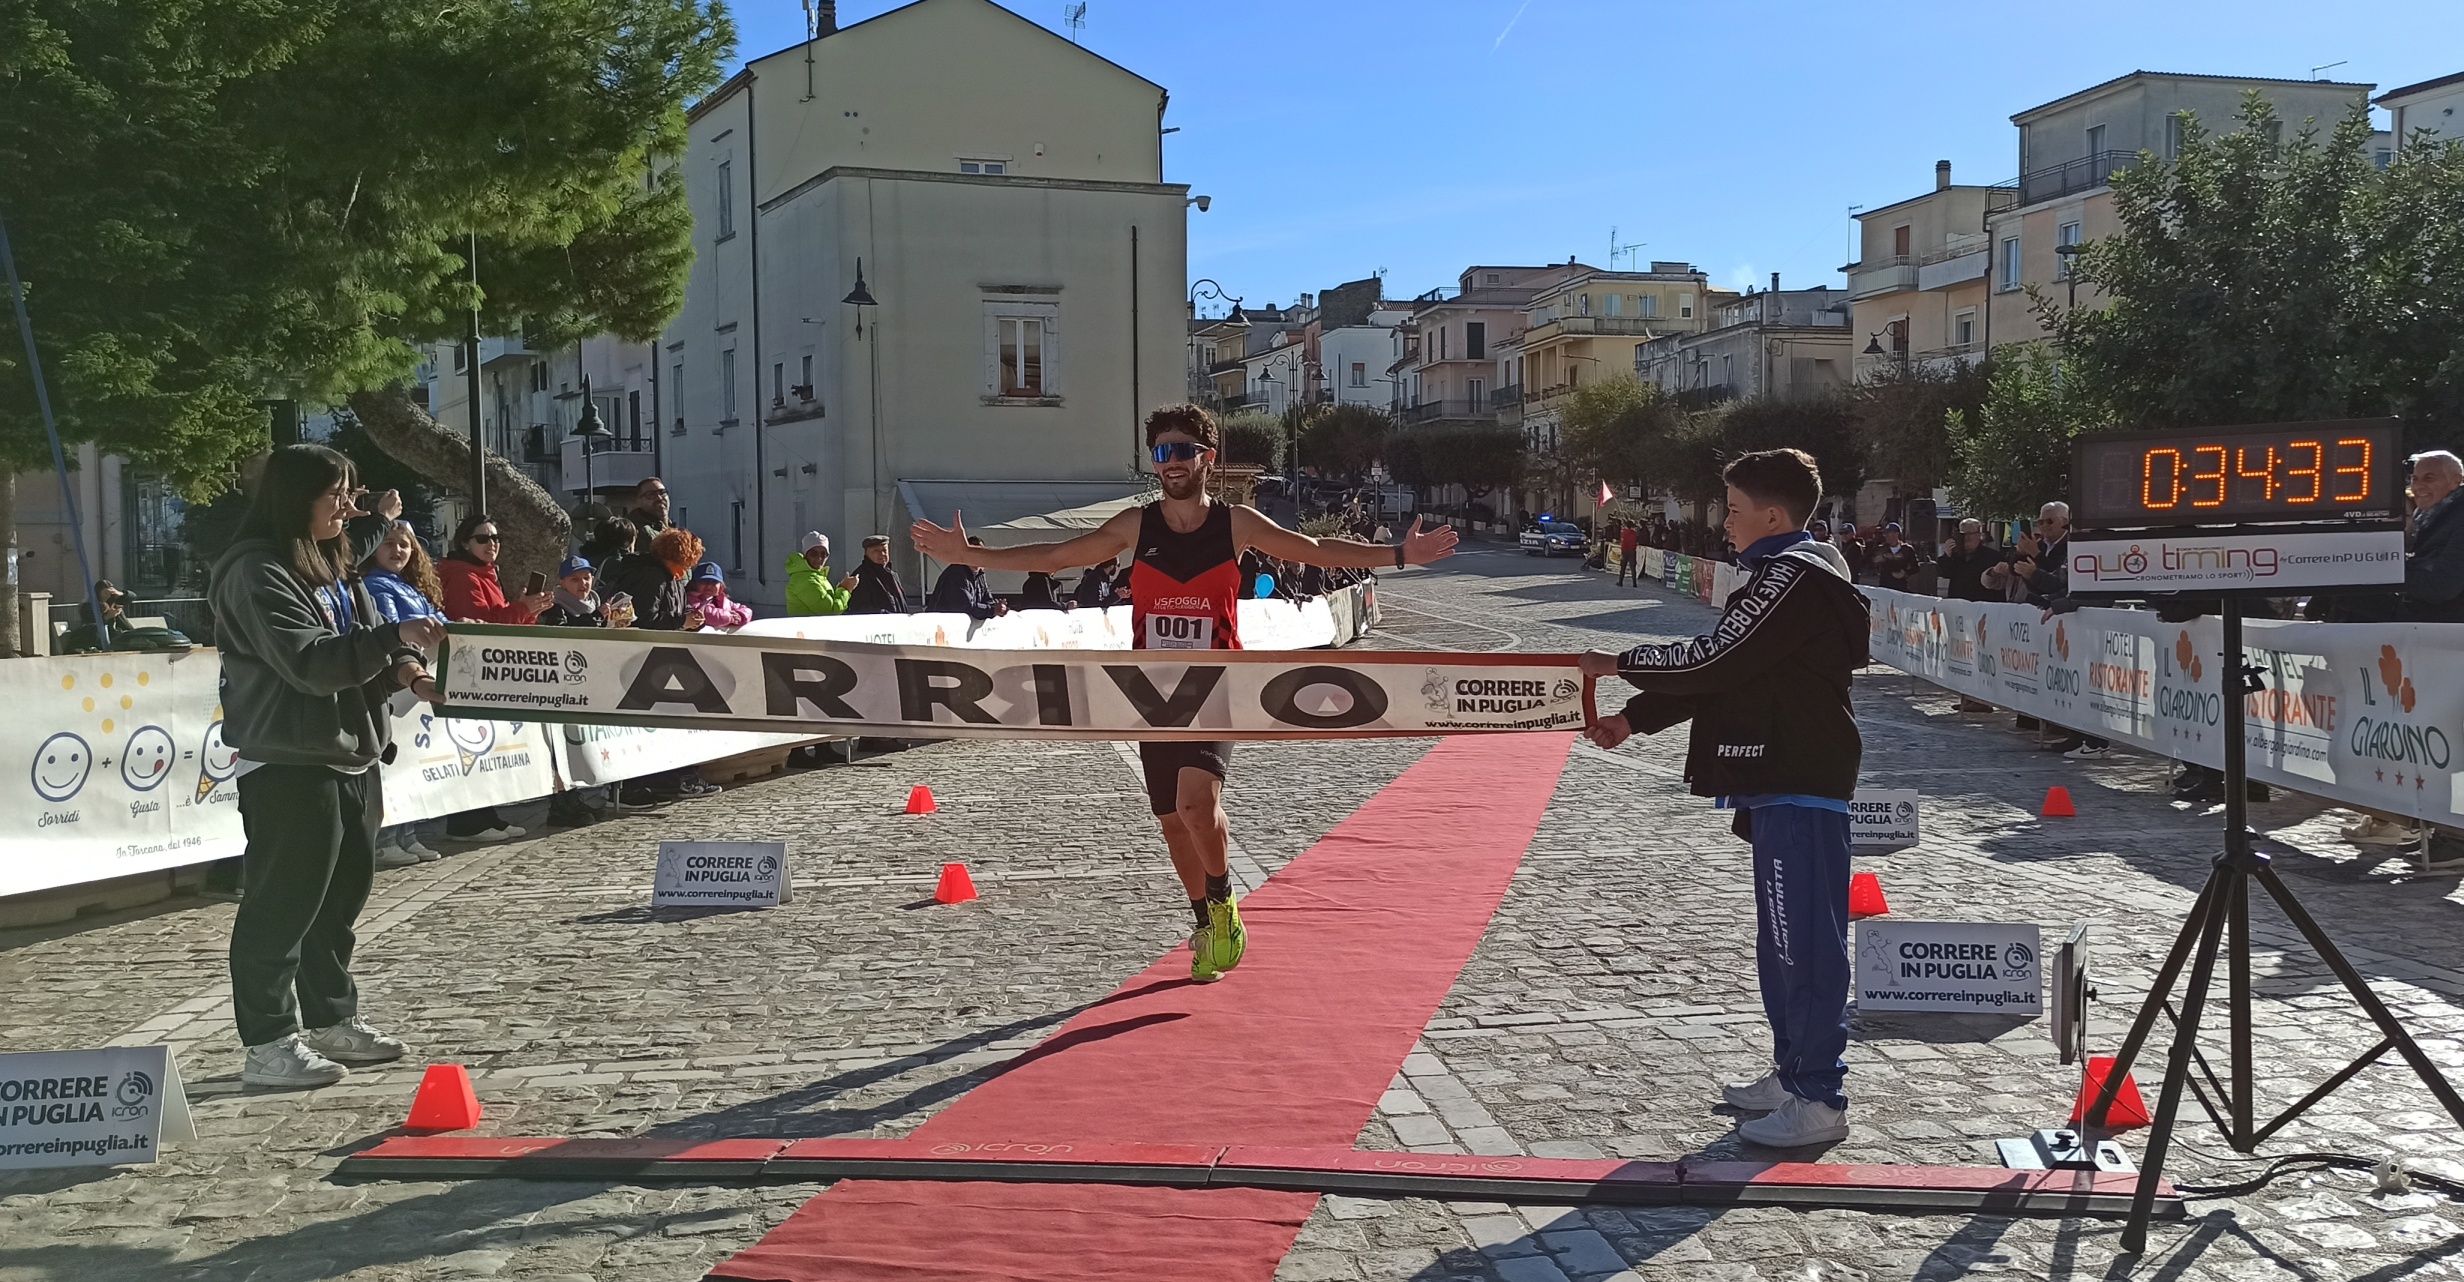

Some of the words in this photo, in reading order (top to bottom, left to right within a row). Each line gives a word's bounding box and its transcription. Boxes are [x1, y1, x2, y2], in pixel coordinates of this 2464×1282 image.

[2142, 438, 2372, 509] 0:34:33
[2162, 543, 2278, 577] timing
[1759, 562, 1797, 600] HAVE
[2135, 572, 2204, 582] CRONOMETRIAMO
[2206, 572, 2216, 580] LO
[2218, 571, 2243, 579] SPORT
[1740, 595, 1770, 616] TO
[1155, 616, 1203, 640] 001
[2104, 631, 2133, 658] HOTEL
[481, 648, 560, 667] CORRERE
[2163, 647, 2172, 678] IL
[481, 666, 498, 682] IN
[500, 667, 560, 684] PUGLIA
[2089, 661, 2148, 698] RISTORANTE
[615, 646, 1389, 729] ARRIVO
[1455, 679, 1547, 697] CORRERE
[2359, 667, 2376, 706] IL
[448, 689, 589, 708] www.correreinpuglia.it
[1457, 698, 1476, 713] IN
[1479, 698, 1546, 714] PUGLIA
[2159, 685, 2220, 727] GIARDINO
[1425, 709, 1582, 730] www.correreinpuglia.it
[2245, 687, 2337, 732] ISTORANTE
[1717, 744, 1765, 758] PERFECT
[2351, 716, 2450, 769] GIARDINO
[422, 763, 460, 782] GELATI
[479, 752, 531, 773] ALL'ITALIANA
[129, 800, 161, 818] Gusta
[1849, 802, 1892, 813] RRERE
[37, 809, 81, 828] Sorridi
[1850, 830, 1916, 841] rereinpuglia.it
[115, 847, 127, 859] In
[183, 836, 202, 848] 1946
[686, 856, 754, 869] CORRERE
[684, 870, 700, 882] IN
[701, 870, 751, 883] PUGLIA
[658, 889, 775, 901] www.correreinpuglia.it
[1899, 942, 1998, 962] CORRERE
[1900, 962, 1922, 979] IN
[1925, 962, 1998, 981] PUGLIA
[1864, 988, 2036, 1007] www.correreinpuglia.it
[0, 1076, 109, 1102] ORRERE
[12, 1102, 105, 1126] PUGLIA
